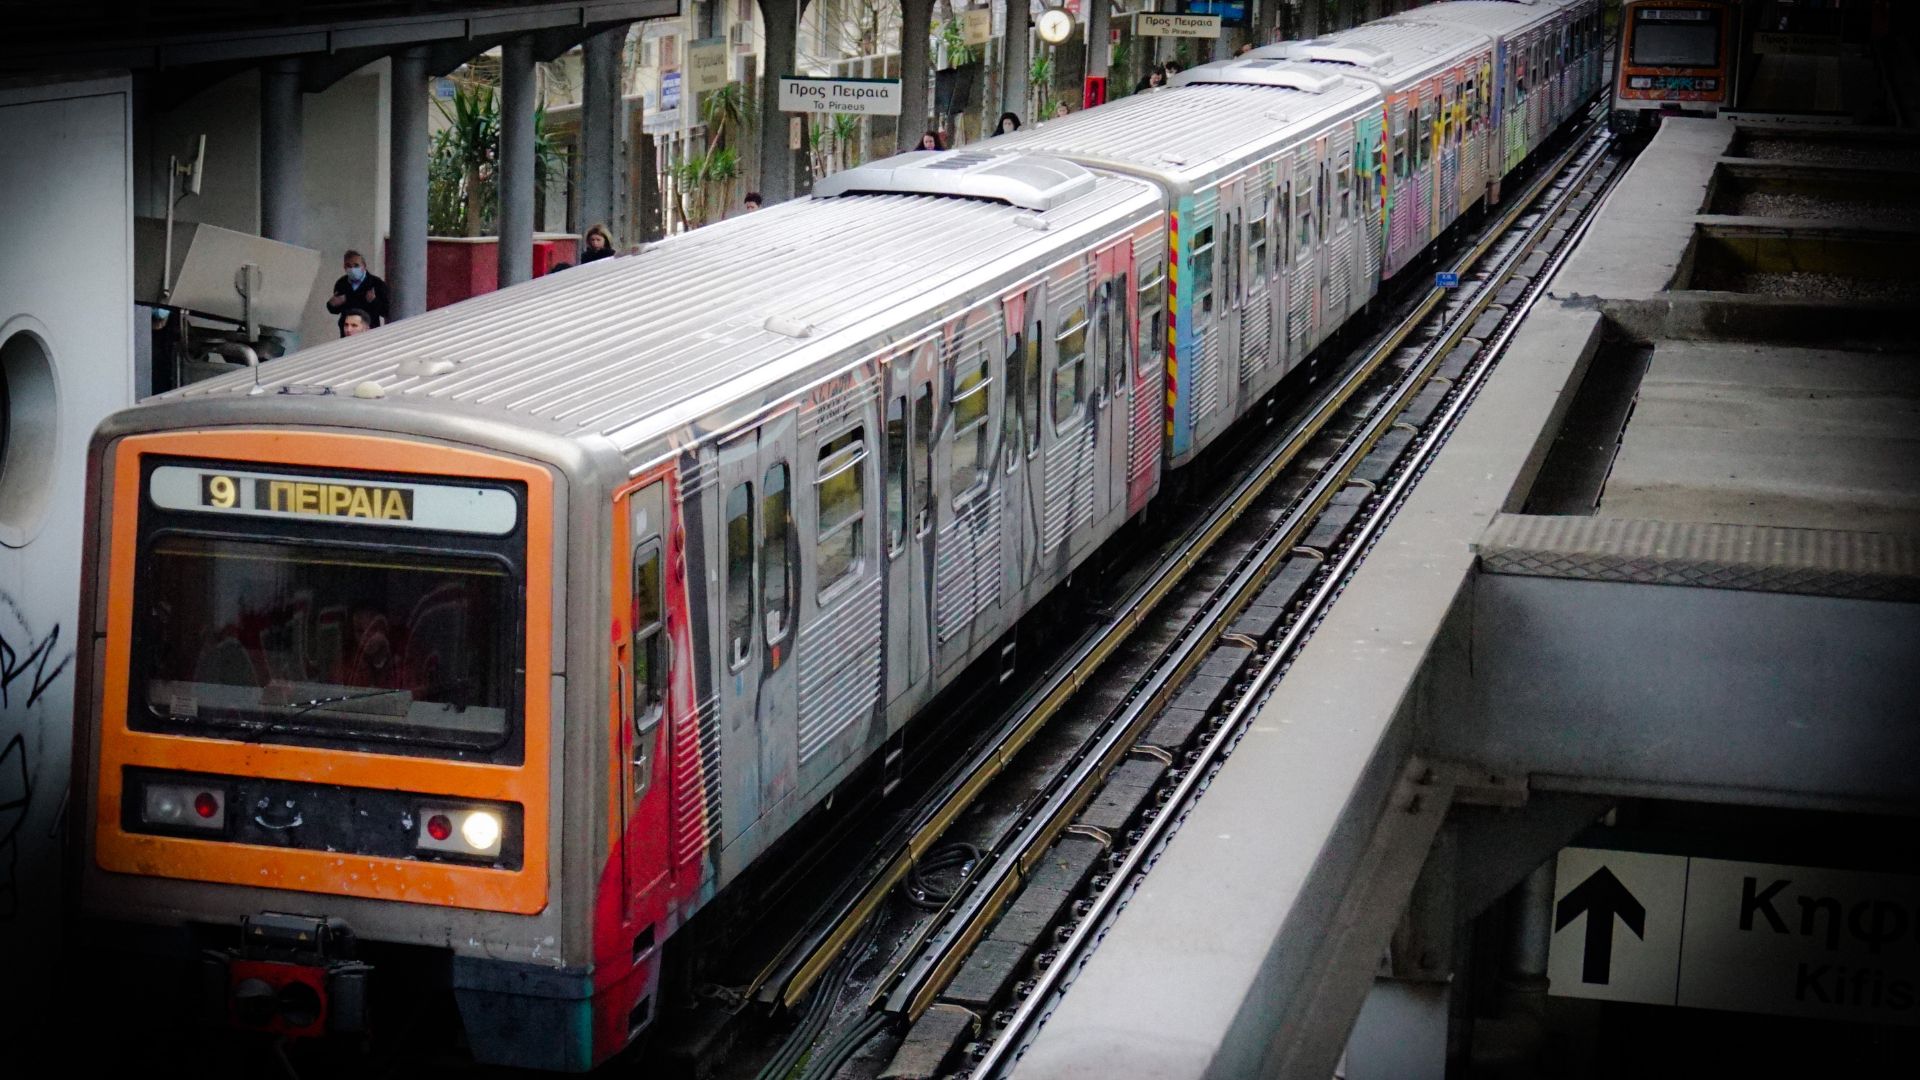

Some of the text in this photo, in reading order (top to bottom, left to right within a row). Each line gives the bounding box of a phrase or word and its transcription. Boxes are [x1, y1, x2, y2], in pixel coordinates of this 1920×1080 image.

[1145, 16, 1170, 27] Προς
[790, 83, 889, 99] Προς Πειραιά
[813, 100, 865, 111] To Piraeus
[209, 475, 409, 521] 9 ΠΕΙΡΑΙΑ
[1739, 876, 1920, 954] Κηφ
[1795, 962, 1920, 1011] Kifis
